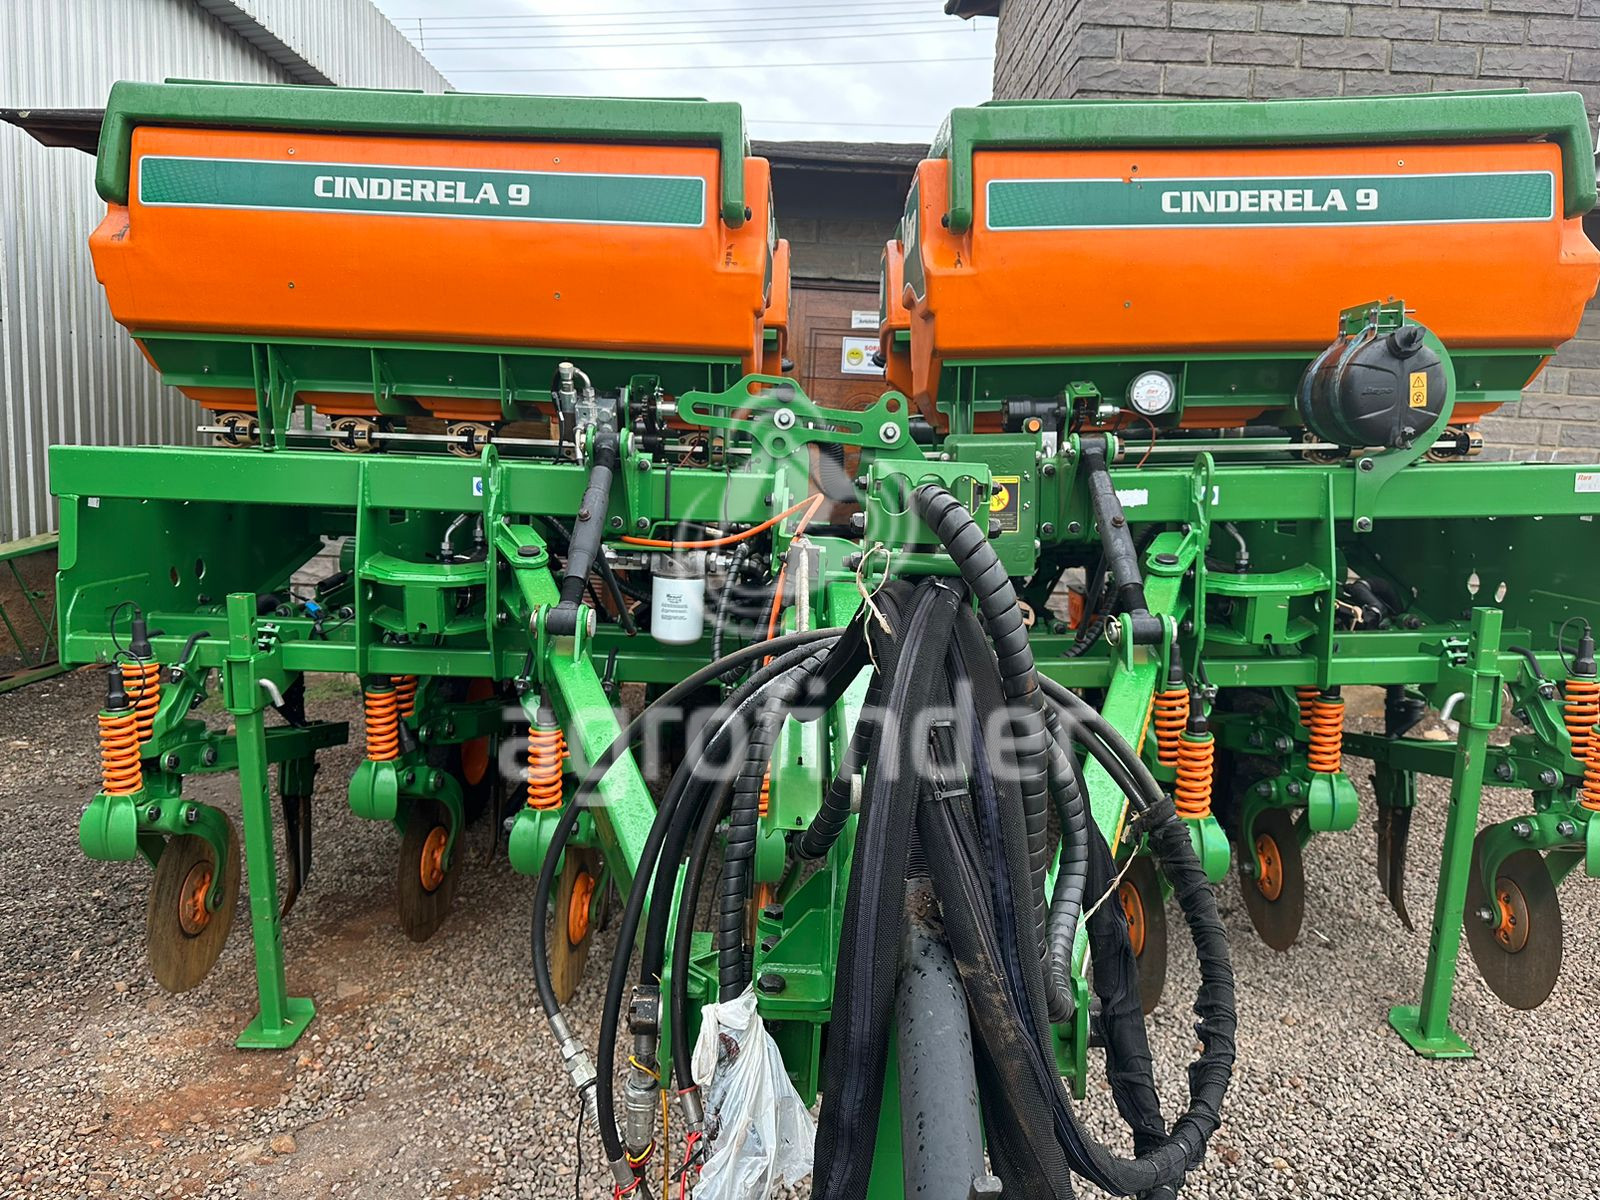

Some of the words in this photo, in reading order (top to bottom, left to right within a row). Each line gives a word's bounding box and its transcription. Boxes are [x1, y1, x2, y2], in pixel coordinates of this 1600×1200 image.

[314, 175, 500, 205] CINDERELA
[507, 184, 530, 206] 9
[1161, 189, 1348, 212] CINDERELA
[1355, 188, 1379, 211] 9
